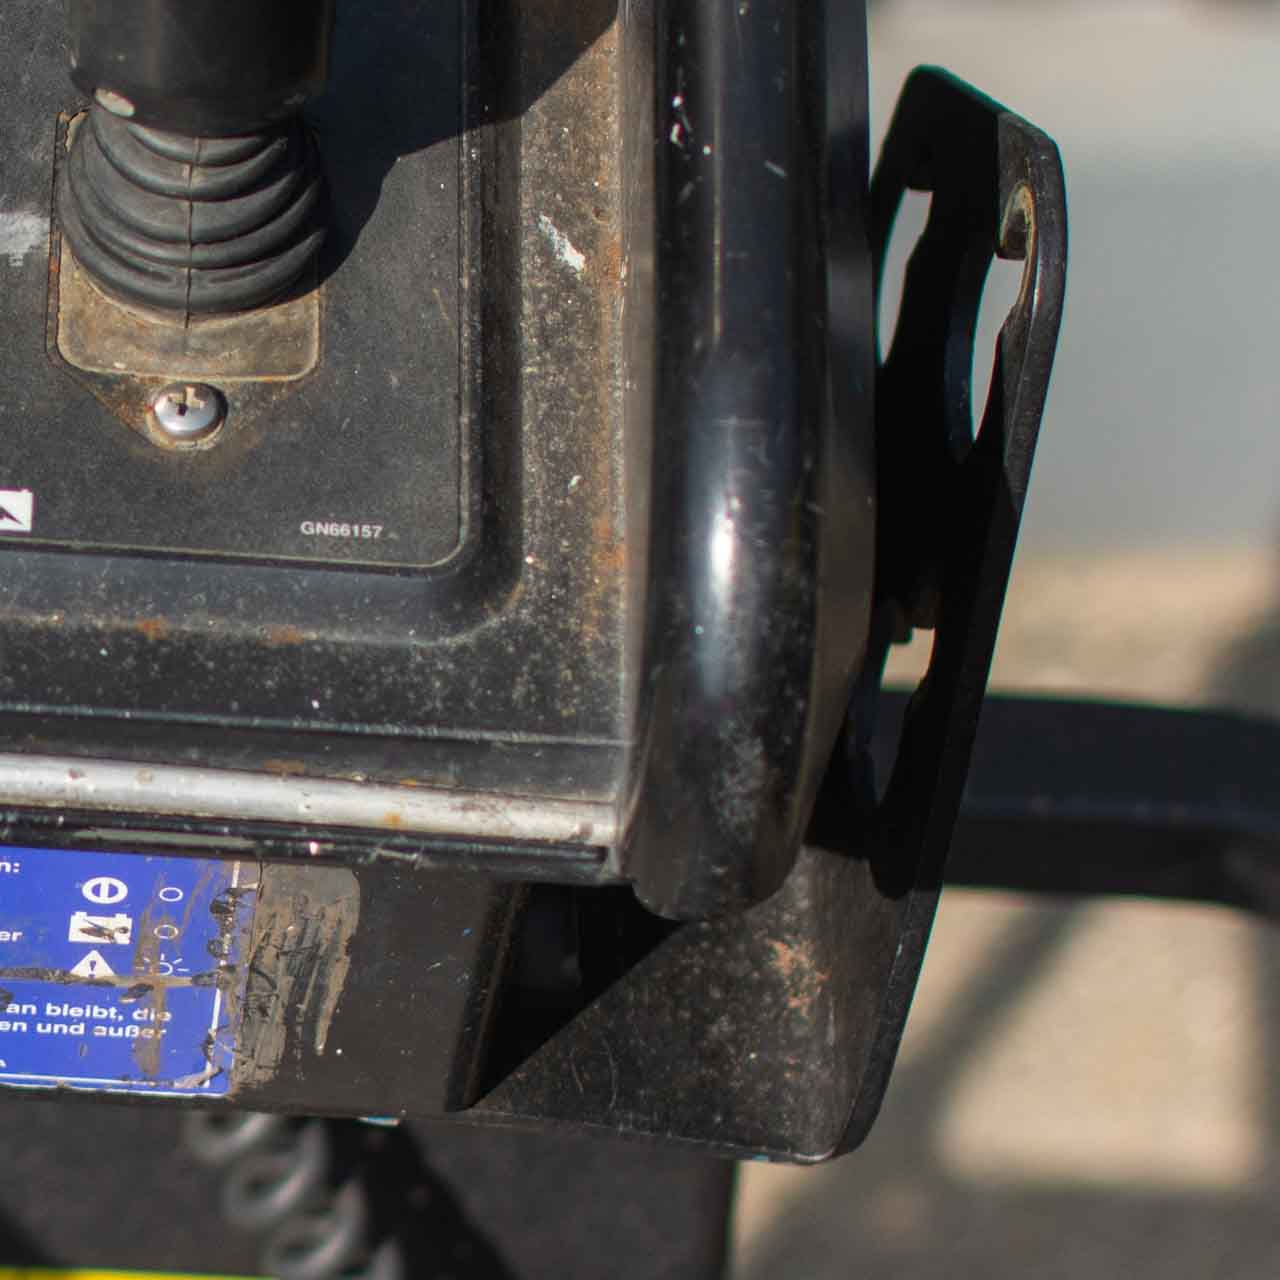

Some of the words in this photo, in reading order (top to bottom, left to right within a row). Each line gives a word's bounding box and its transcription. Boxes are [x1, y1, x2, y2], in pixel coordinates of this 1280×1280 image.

[300, 520, 384, 539] GN66157
[6, 1002, 36, 1015] an
[45, 1002, 125, 1021] bleibt,
[131, 1008, 173, 1022] die
[36, 1021, 85, 1036] und
[93, 1023, 168, 1039] außer
